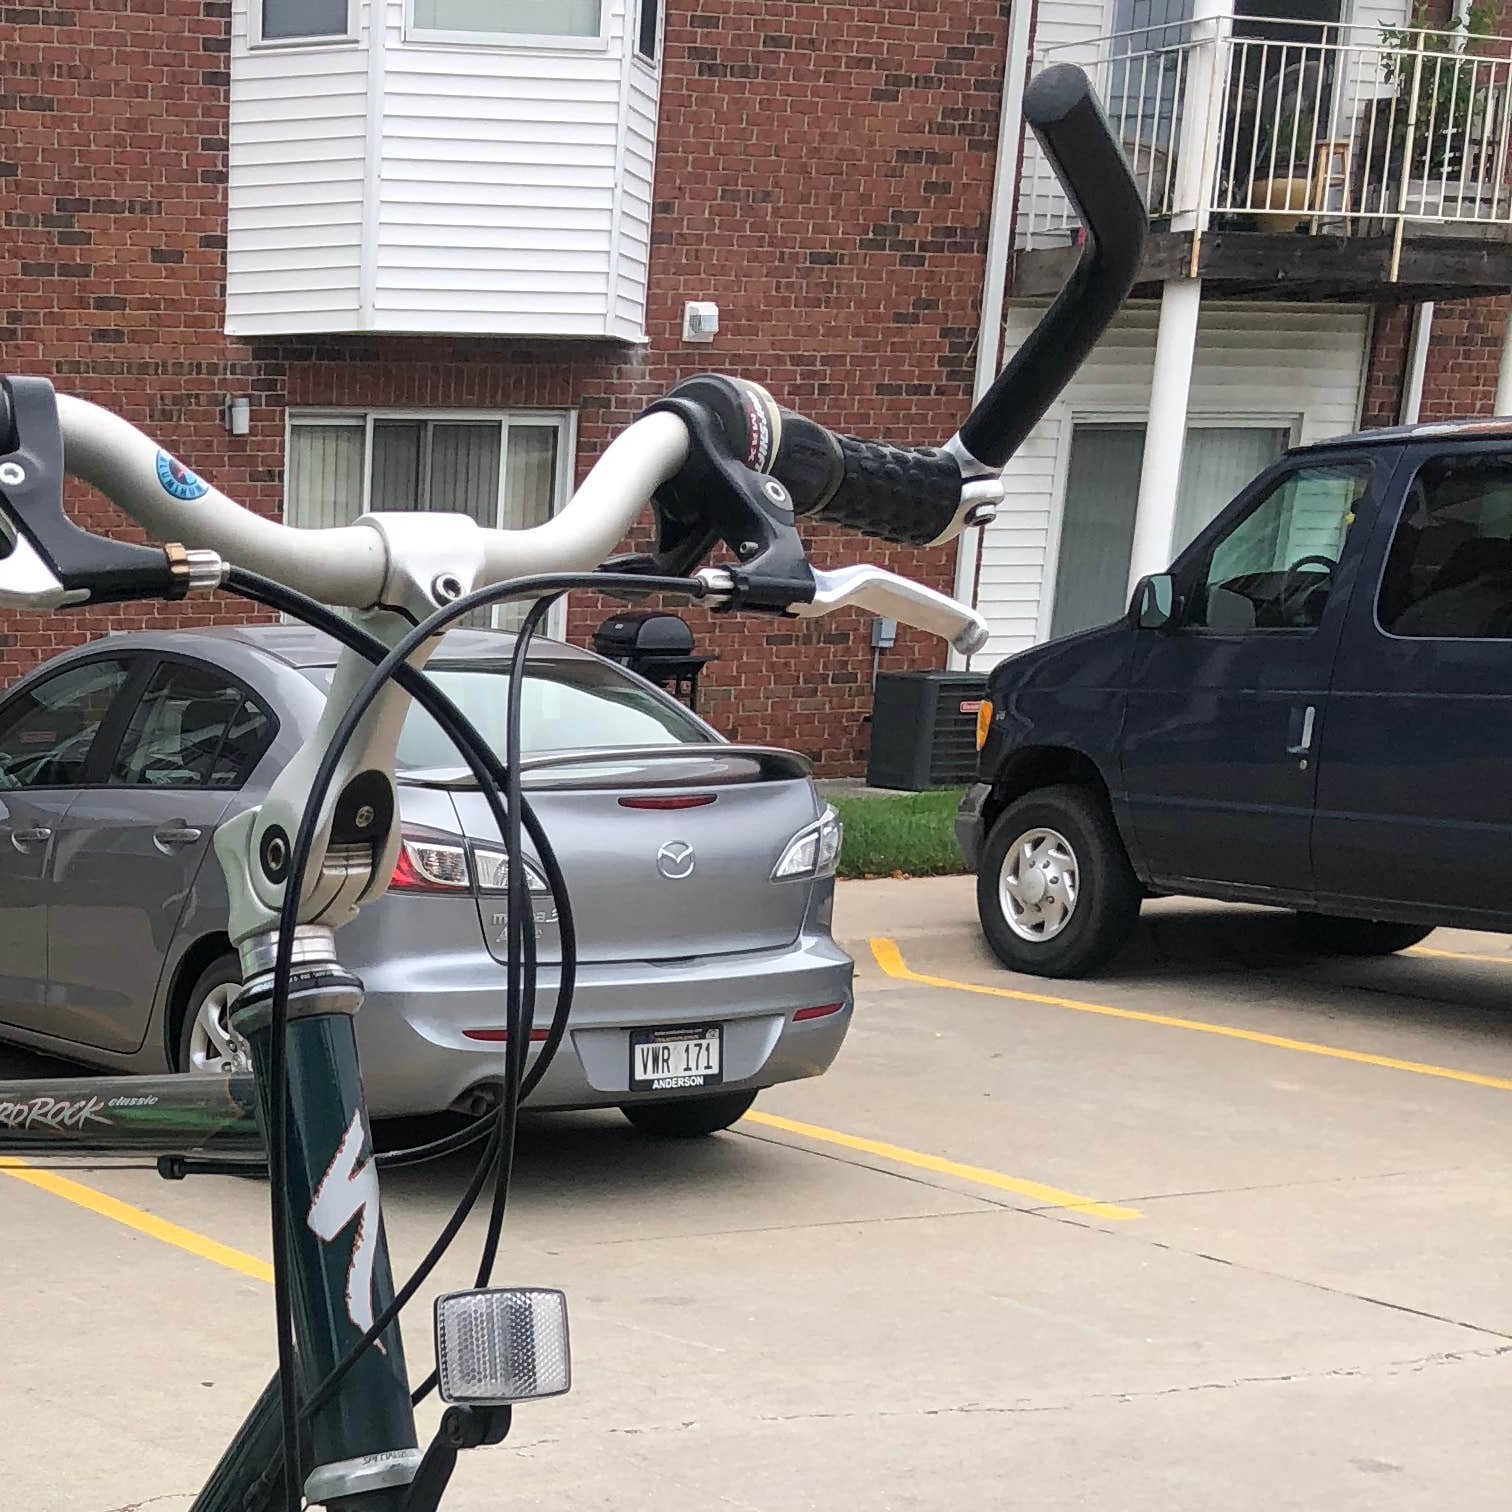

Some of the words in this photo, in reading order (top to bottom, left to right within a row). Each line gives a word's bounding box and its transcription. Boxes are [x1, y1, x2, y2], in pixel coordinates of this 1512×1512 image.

[641, 1045, 671, 1075] VWR
[683, 1042, 713, 1072] 171
[652, 1076, 704, 1089] ANDERSON
[108, 1094, 159, 1107] classic
